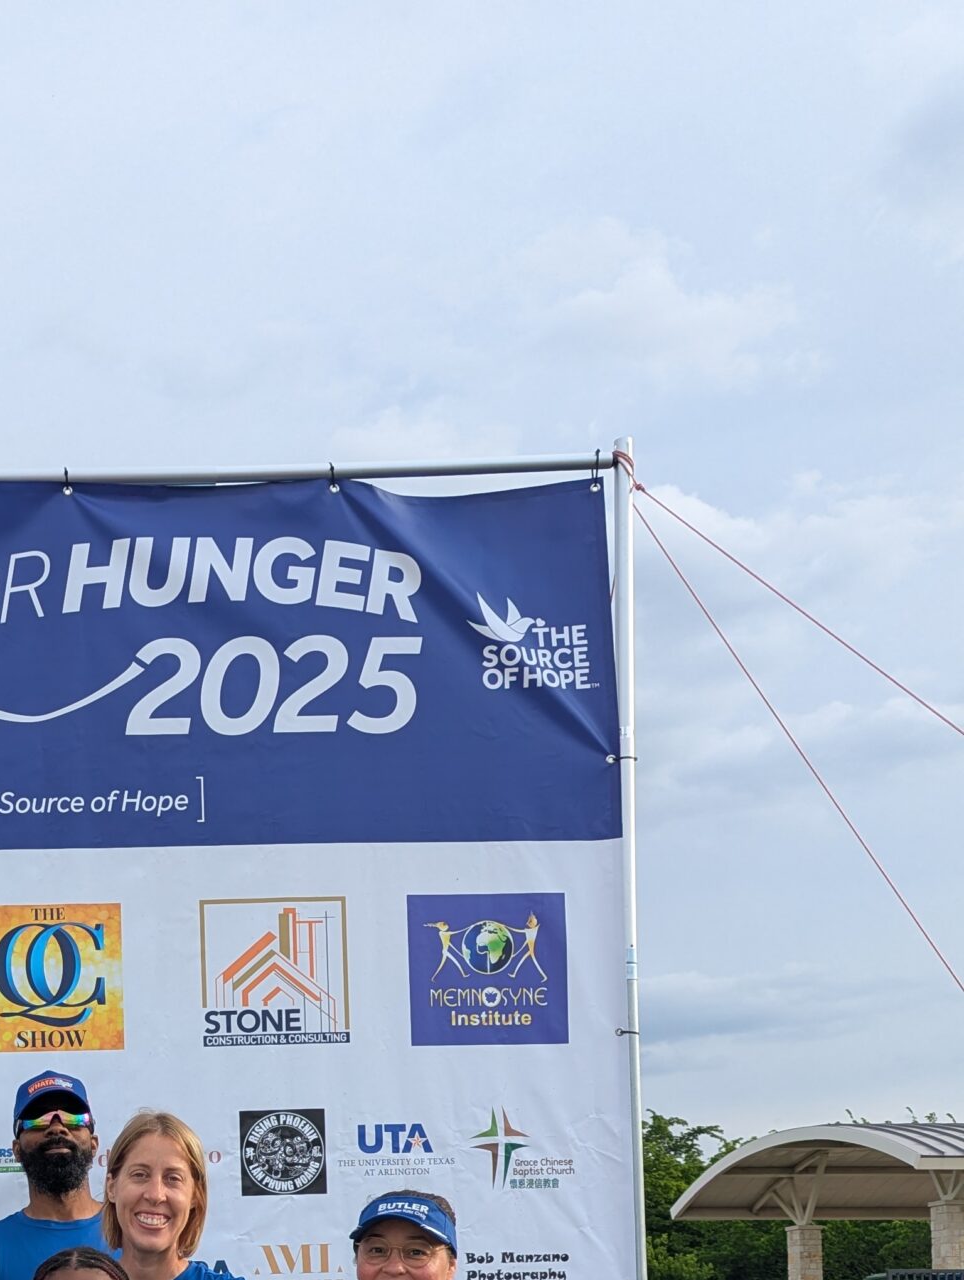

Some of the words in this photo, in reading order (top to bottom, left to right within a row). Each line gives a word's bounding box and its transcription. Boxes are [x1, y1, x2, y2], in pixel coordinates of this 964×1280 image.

[61, 536, 423, 624] HUNGER
[532, 624, 589, 648] THE
[482, 645, 590, 671] SOURCE
[125, 635, 423, 737] 2025
[482, 667, 518, 690] OF
[521, 667, 591, 691] HOPE
[90, 789, 117, 814] of
[121, 789, 189, 817] Hope
[31, 907, 66, 921] THE
[204, 1008, 301, 1034] STONE
[450, 1010, 533, 1027] Institute
[16, 1029, 88, 1049] SHOW
[206, 1034, 279, 1046] CONSTRUCTION
[280, 1034, 287, 1044] &
[288, 1032, 348, 1045] CONSULTING
[248, 1115, 278, 1144] RISING
[279, 1114, 318, 1142] PHOENIX
[357, 1123, 434, 1154] UTA
[337, 1159, 357, 1168] THE
[358, 1158, 411, 1167] UNIVERSITY
[427, 1157, 455, 1165] TEXAS
[377, 1168, 430, 1176] ARLINGTON
[512, 1166, 545, 1178] Baptist
[546, 1166, 575, 1175] Church
[514, 1158, 539, 1167] Grace
[540, 1157, 574, 1167] Chinese
[378, 1202, 429, 1214] BUTLER
[465, 1252, 494, 1264] Bob
[501, 1252, 570, 1264] Manzano
